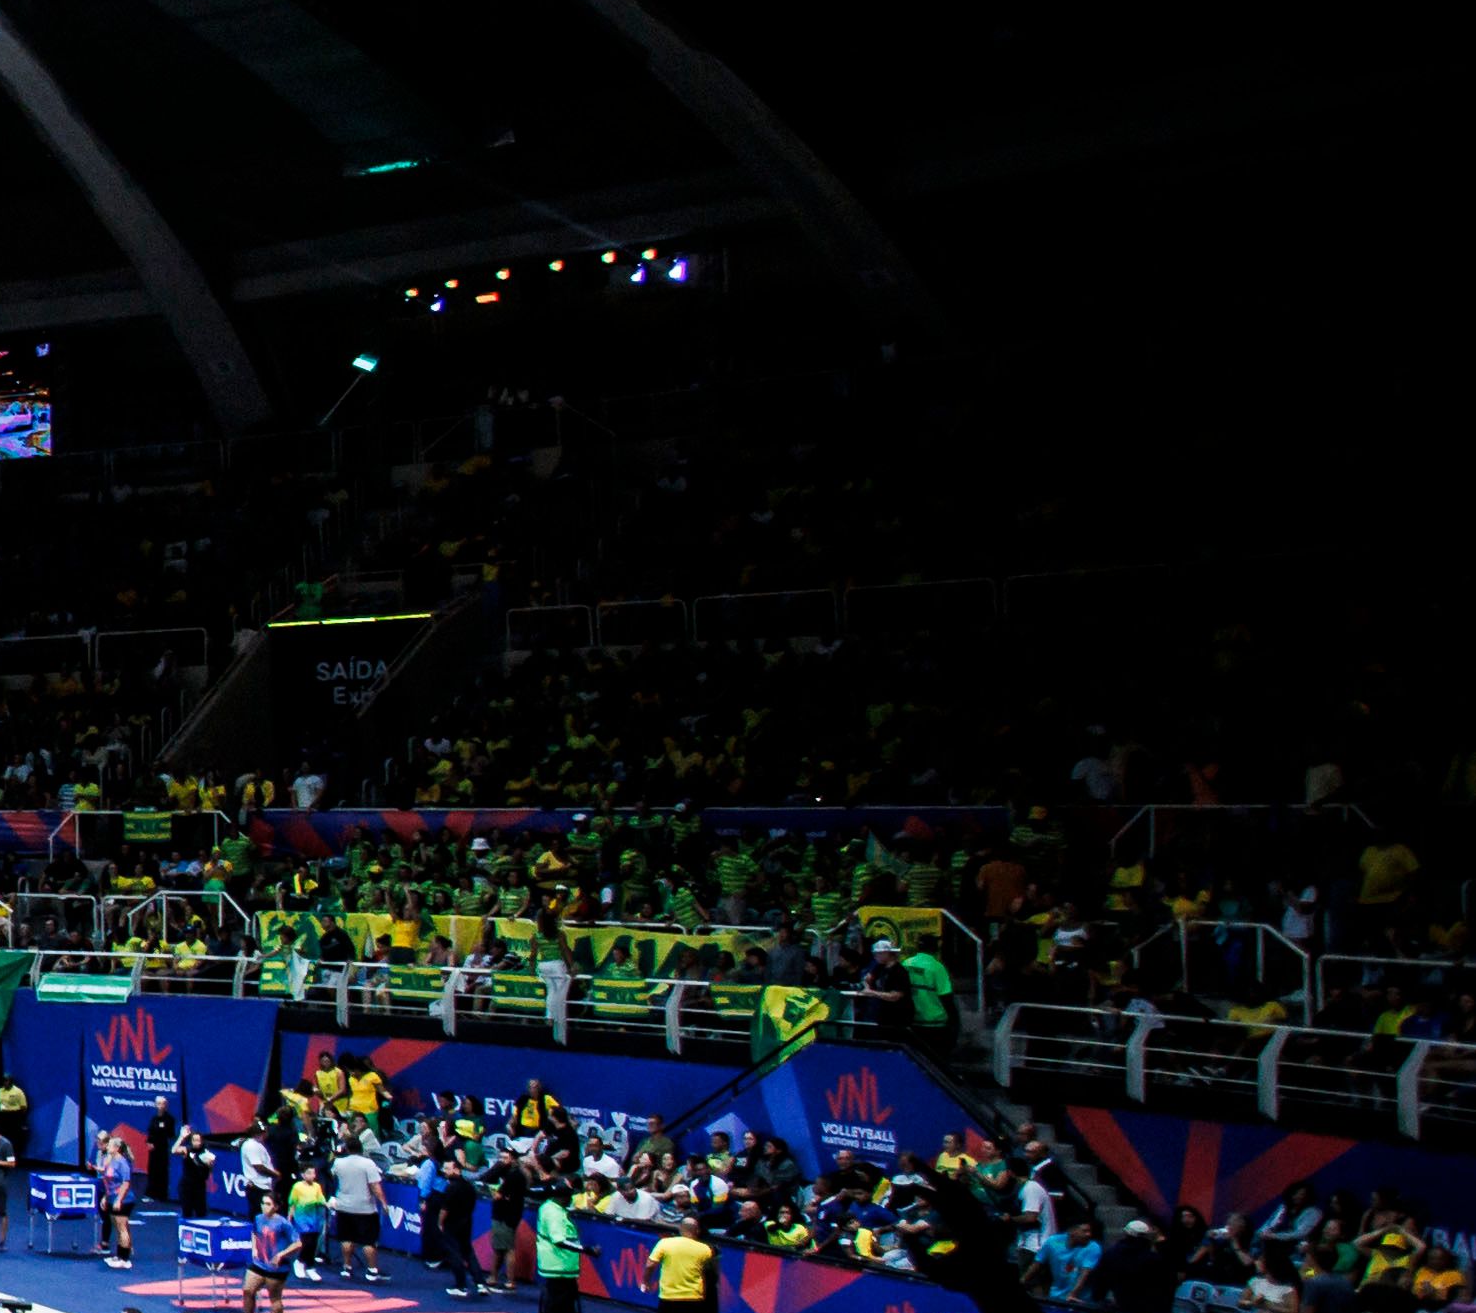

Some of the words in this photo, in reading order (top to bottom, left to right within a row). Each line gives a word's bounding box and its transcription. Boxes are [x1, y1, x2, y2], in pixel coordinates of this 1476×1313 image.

[315, 655, 387, 681] SAÍDA
[91, 1064, 177, 1082] VOLLEYBALL
[92, 1078, 136, 1090] NATIONS
[138, 1080, 177, 1093] LEAGUE
[821, 1122, 896, 1143] VOLLEYBALL
